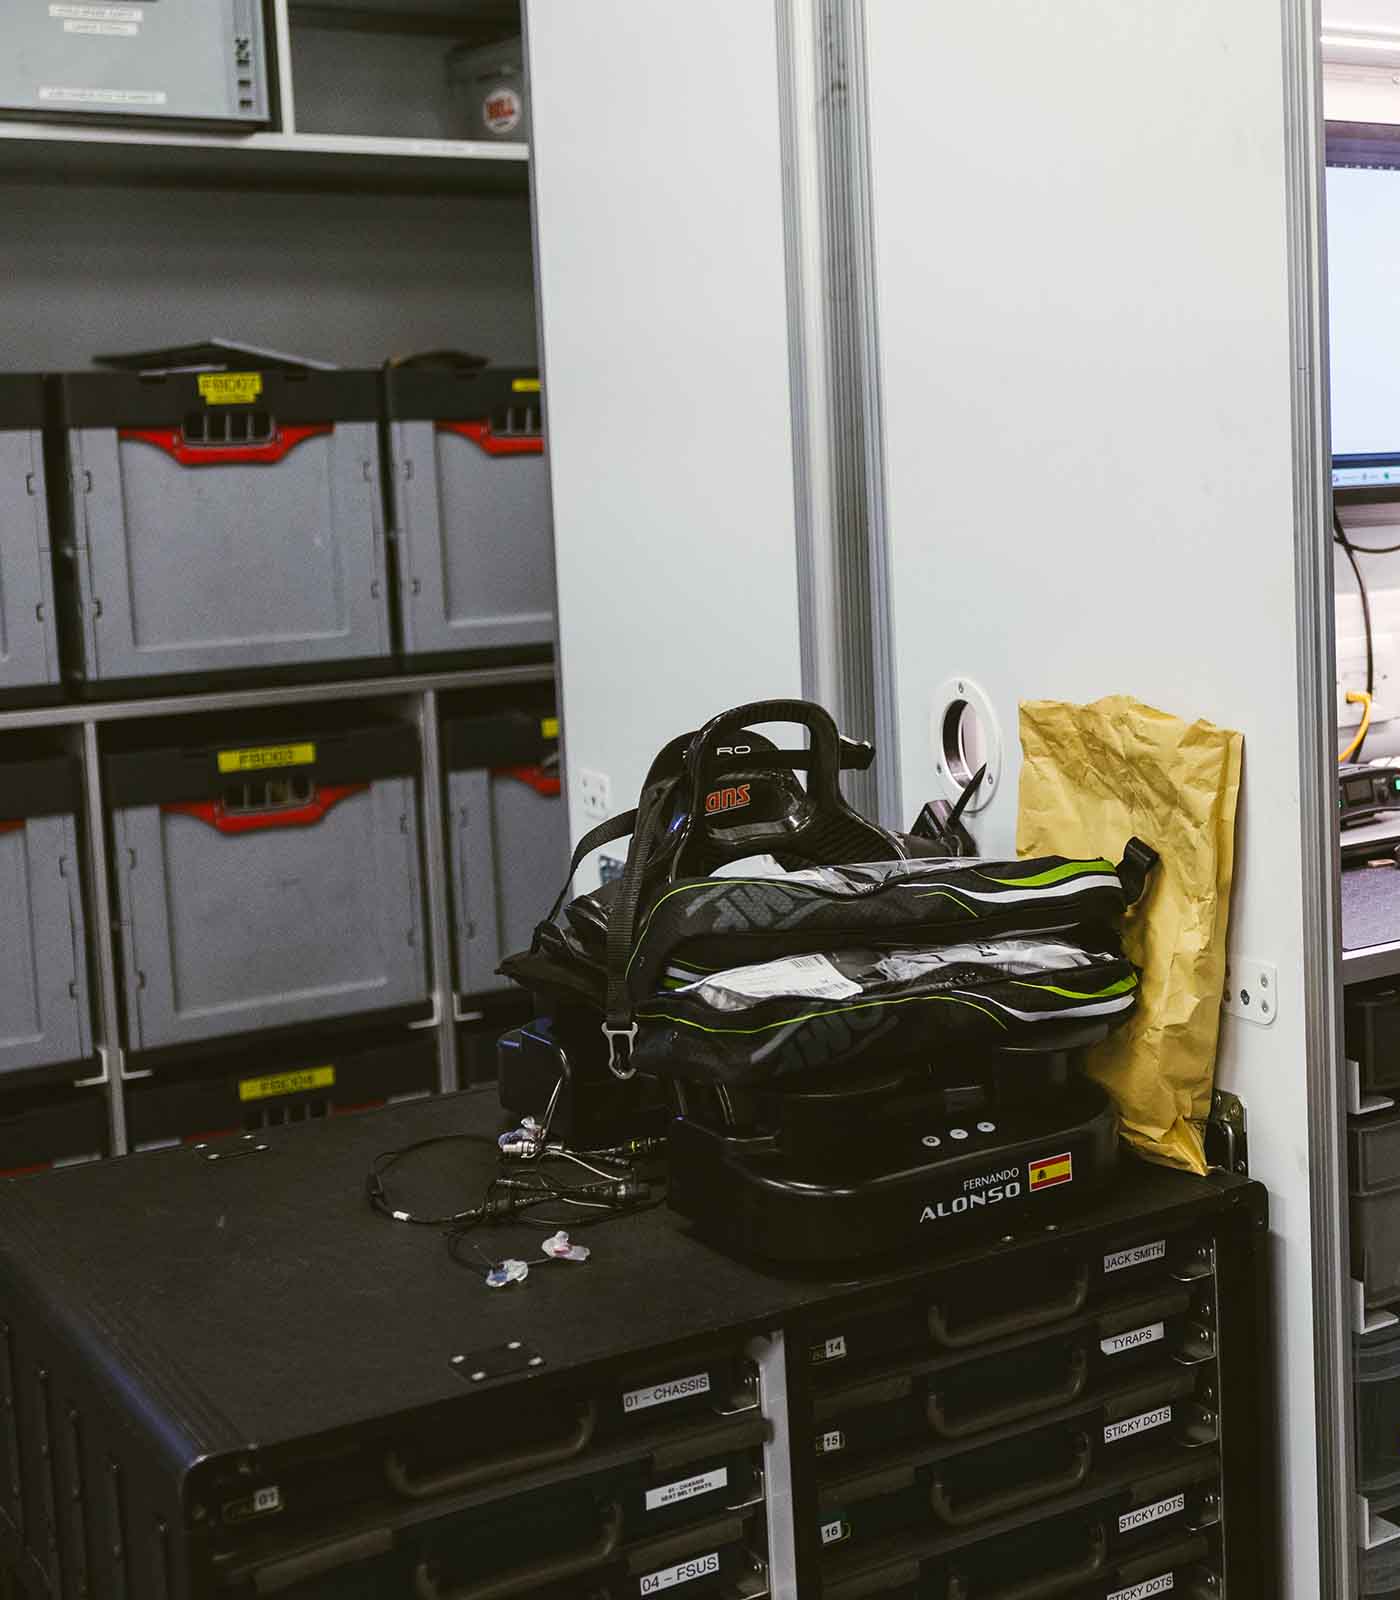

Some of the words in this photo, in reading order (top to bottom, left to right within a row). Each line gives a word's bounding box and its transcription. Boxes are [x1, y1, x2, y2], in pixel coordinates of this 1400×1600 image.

[963, 1167, 1020, 1191] FERNANDO
[919, 1182, 1021, 1223] ALONSO
[1105, 1253, 1131, 1269] JACK
[1134, 1244, 1164, 1260] SMITH
[827, 1341, 841, 1353] 14
[1112, 1330, 1152, 1350] TYRAPS
[625, 1395, 638, 1408] 01
[654, 1377, 707, 1400] CHASSIS
[1105, 1419, 1141, 1439] STICKY
[1144, 1410, 1170, 1427] DOTS
[826, 1435, 838, 1446] 15
[1120, 1508, 1155, 1529] STICKY
[1157, 1497, 1184, 1515] DOTS
[825, 1526, 838, 1537] 16
[642, 1576, 659, 1592] 04
[677, 1556, 717, 1581] FSUS
[1146, 1576, 1172, 1592] DOTS
